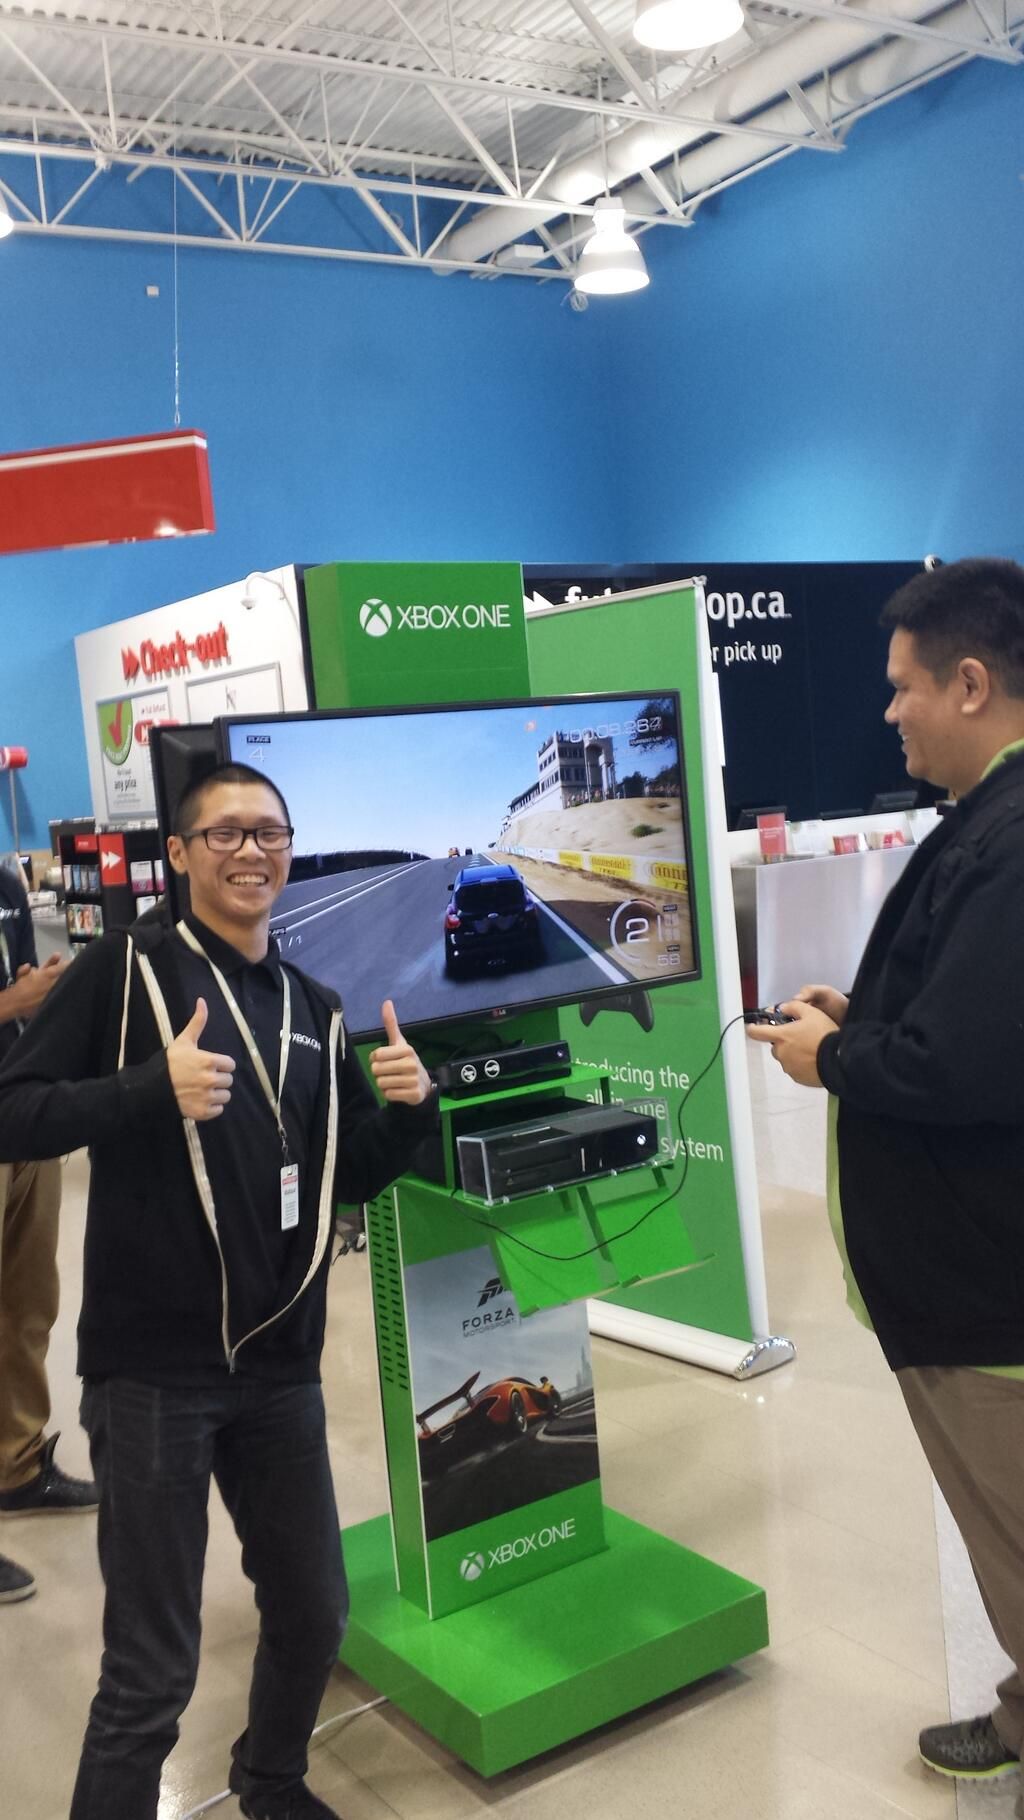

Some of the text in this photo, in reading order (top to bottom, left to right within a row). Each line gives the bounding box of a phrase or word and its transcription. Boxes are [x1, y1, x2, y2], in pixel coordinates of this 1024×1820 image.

[396, 604, 511, 630] XBOX ONE
[140, 620, 230, 678] Check-out
[724, 640, 757, 666] pick
[762, 642, 783, 664] up
[626, 917, 649, 943] 2
[659, 1066, 690, 1089] the
[660, 1136, 724, 1162] system
[462, 1306, 515, 1331] FORZA
[488, 1518, 576, 1570] XBOX ONE
